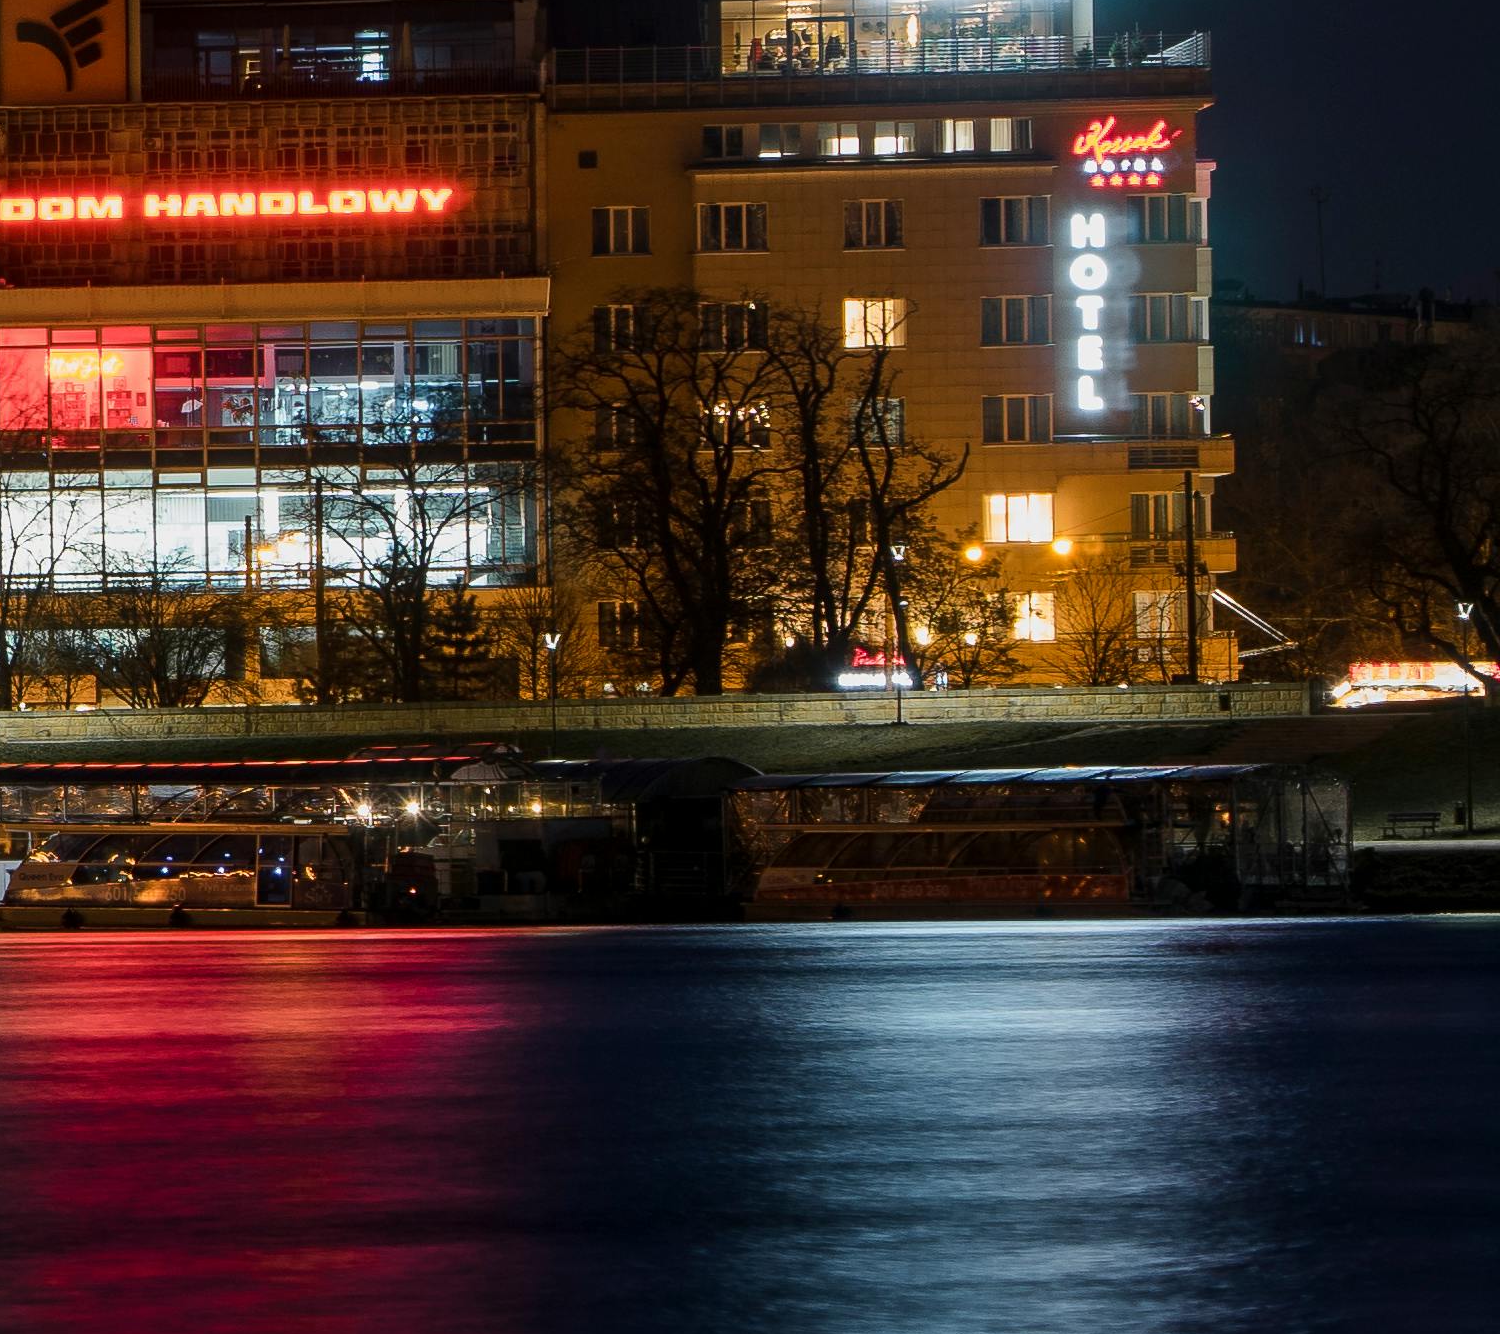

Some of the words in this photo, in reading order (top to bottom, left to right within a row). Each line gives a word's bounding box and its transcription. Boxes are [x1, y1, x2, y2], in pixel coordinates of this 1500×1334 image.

[0, 195, 123, 221] DOM
[144, 188, 453, 217] HANDLOWY
[1069, 212, 1109, 411] HOTEL
[106, 886, 128, 902] 601
